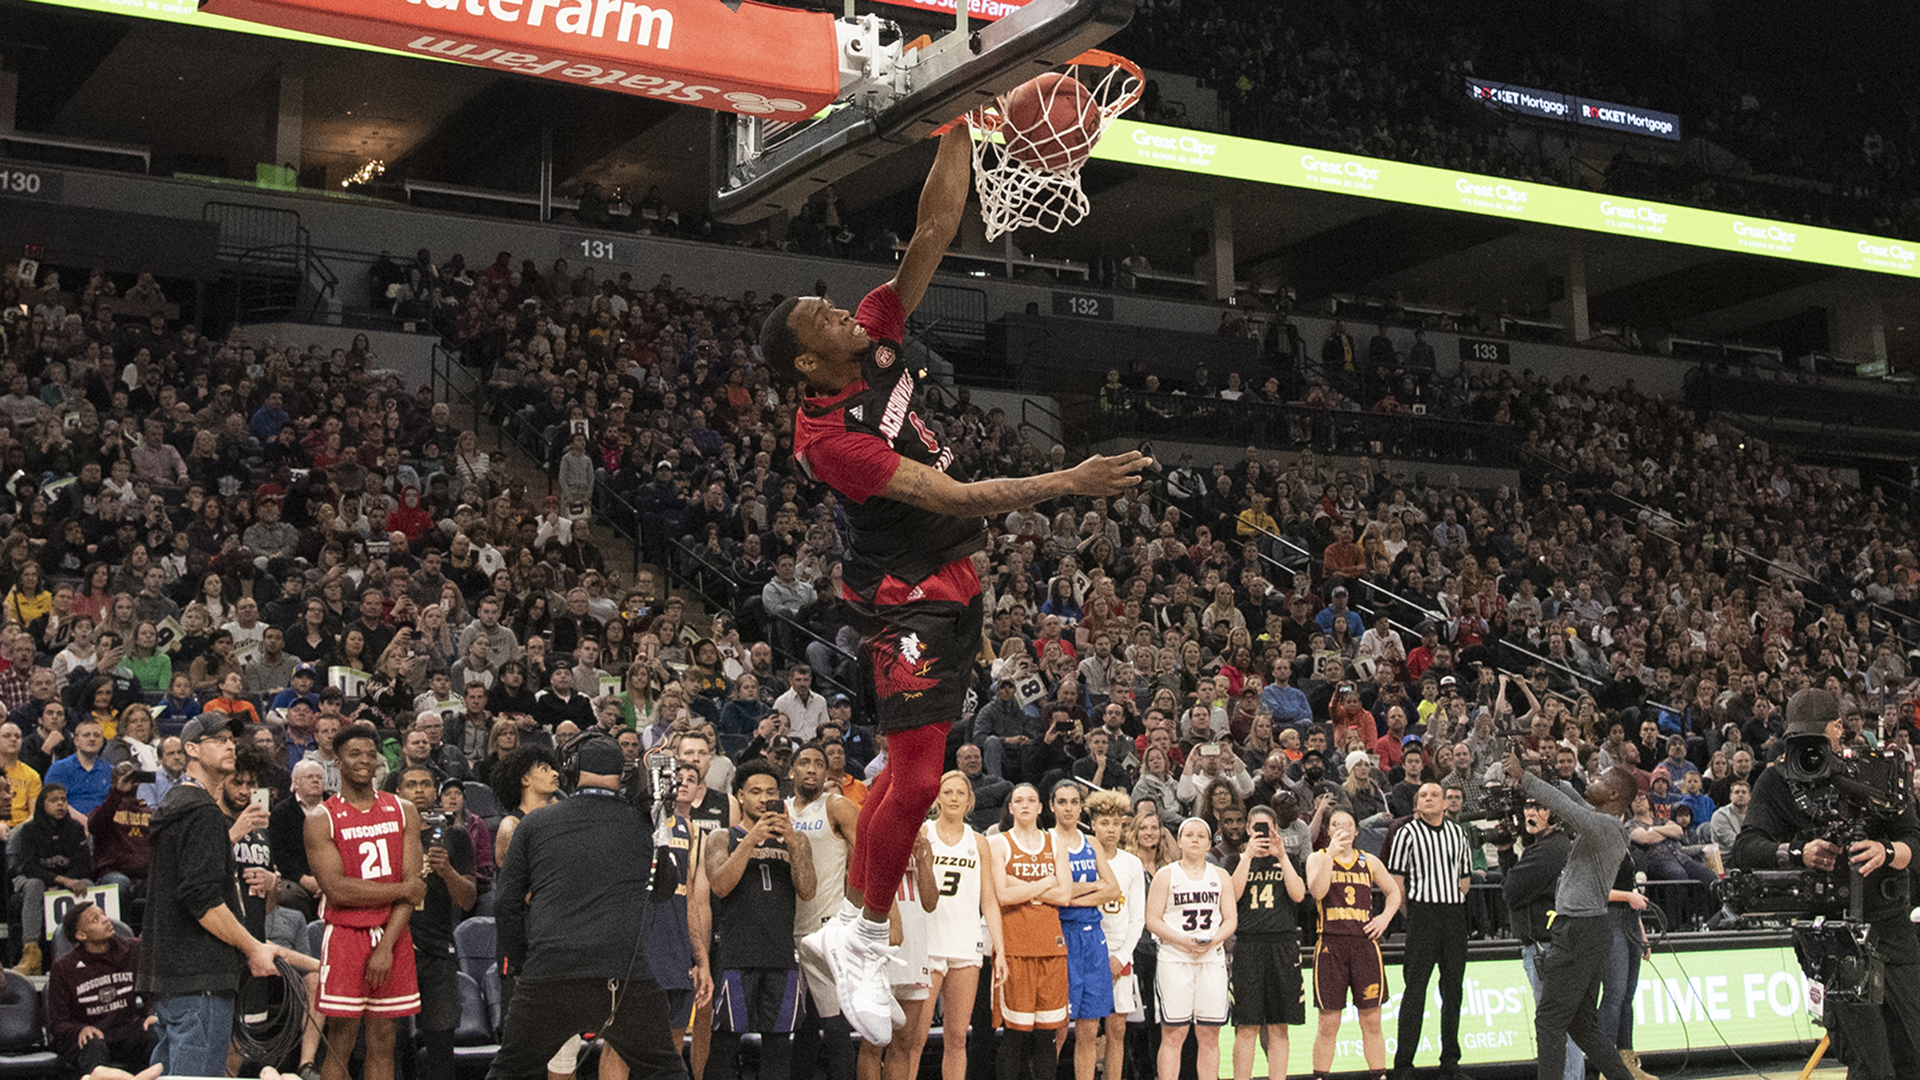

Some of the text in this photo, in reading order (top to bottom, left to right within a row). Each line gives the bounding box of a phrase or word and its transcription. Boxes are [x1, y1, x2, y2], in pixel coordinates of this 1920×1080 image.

[162, 4, 193, 15] GREAT
[1582, 105, 1673, 134] ROCKET Mortgage
[1132, 129, 1216, 157] Great Clips
[1152, 153, 1177, 162] GONNA
[1189, 157, 1211, 166] GREAT
[1301, 155, 1378, 181] Great Clips
[0, 170, 41, 193] 130
[1320, 177, 1343, 186] GONNA
[1354, 181, 1374, 191] GREAT
[1455, 178, 1527, 204] Great Clips
[1473, 199, 1495, 209] GONNA
[1505, 204, 1523, 213] GREAT
[1600, 201, 1666, 225] Great Clips
[1646, 225, 1663, 234] GREAT
[1733, 221, 1795, 244] Great Clips
[581, 239, 614, 260] 131
[1857, 240, 1916, 263] Great Clips
[1068, 297, 1099, 316] 132
[1473, 343, 1498, 360] 133
[1021, 679, 1041, 698] 8
[341, 821, 400, 840] WISCONSIN
[793, 820, 823, 831] FALO
[359, 838, 392, 880] 21
[933, 855, 976, 869] IZZOU
[1012, 863, 1055, 876] TEXAS
[759, 863, 772, 891] 1
[939, 871, 961, 897] 3
[1247, 870, 1284, 882] DAHO
[1331, 870, 1371, 888] ENTRAL
[1173, 891, 1219, 906] BELMONT
[1250, 884, 1274, 909] 14
[1344, 885, 1356, 906] 3
[1182, 909, 1213, 931] 33
[76, 971, 134, 995] MISSOURI STATE
[1635, 974, 1731, 1026] TIME
[1464, 1031, 1514, 1050] GREAT
